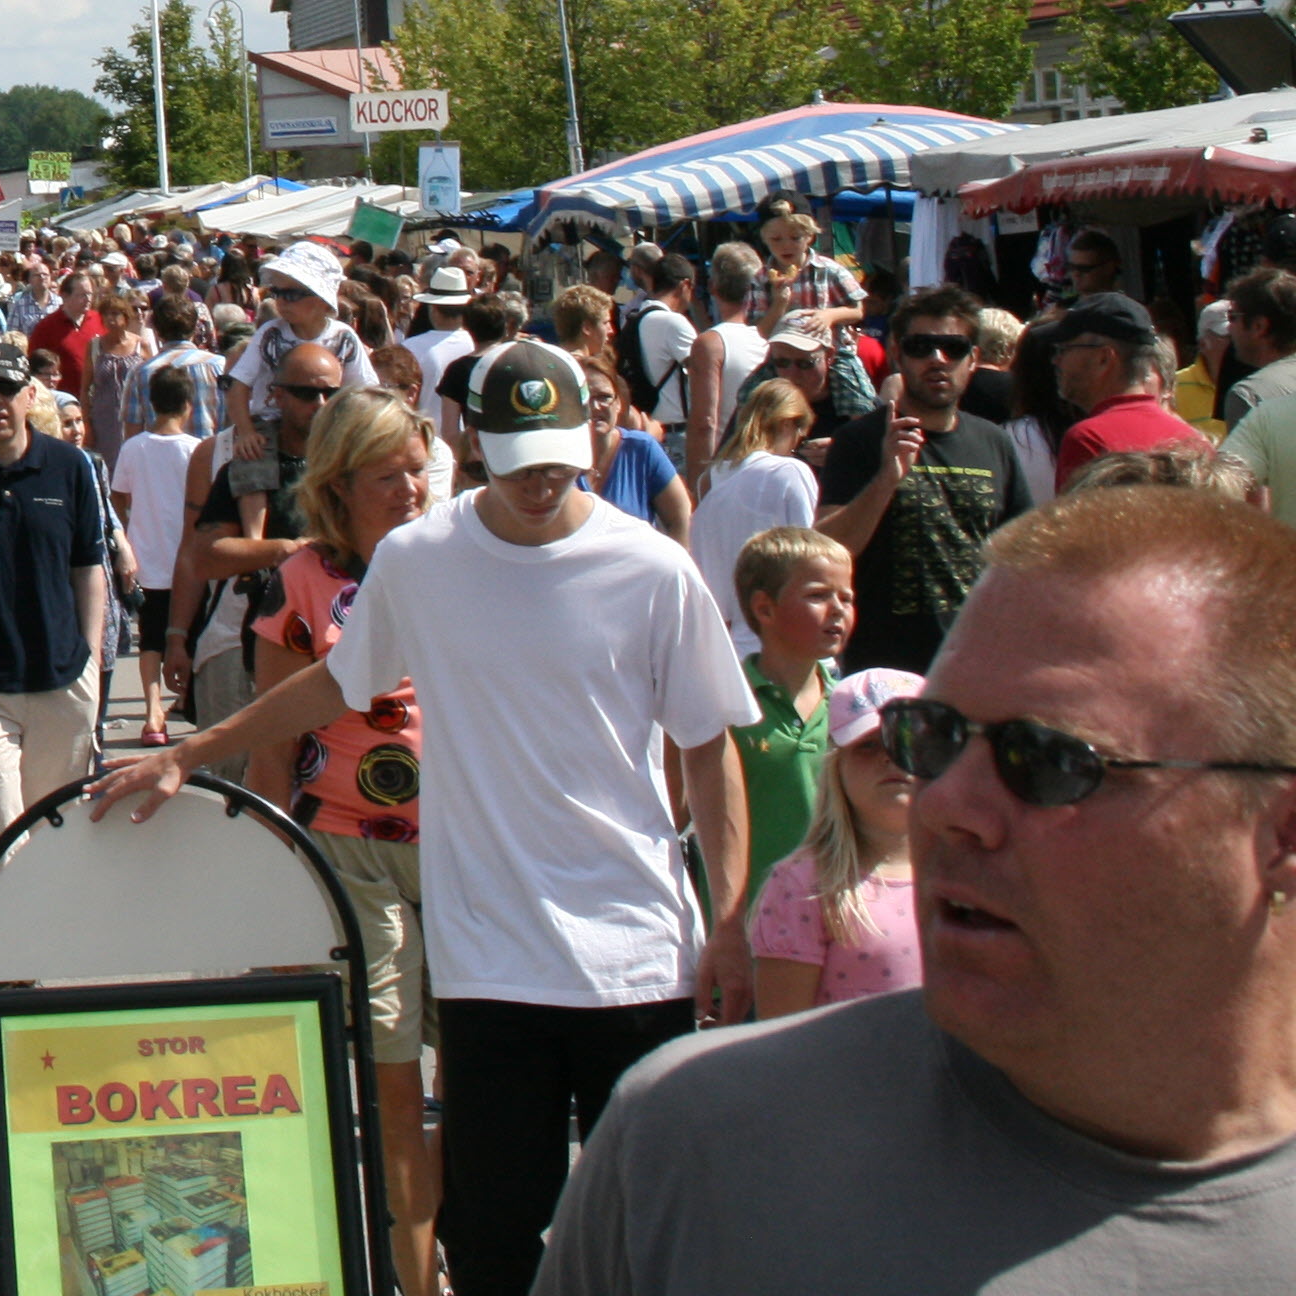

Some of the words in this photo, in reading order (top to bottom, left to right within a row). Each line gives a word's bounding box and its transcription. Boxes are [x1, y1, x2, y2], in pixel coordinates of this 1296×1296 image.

[357, 98, 440, 124] KLOCKOR
[137, 1036, 207, 1056] STOR
[56, 1074, 303, 1124] BOKREA
